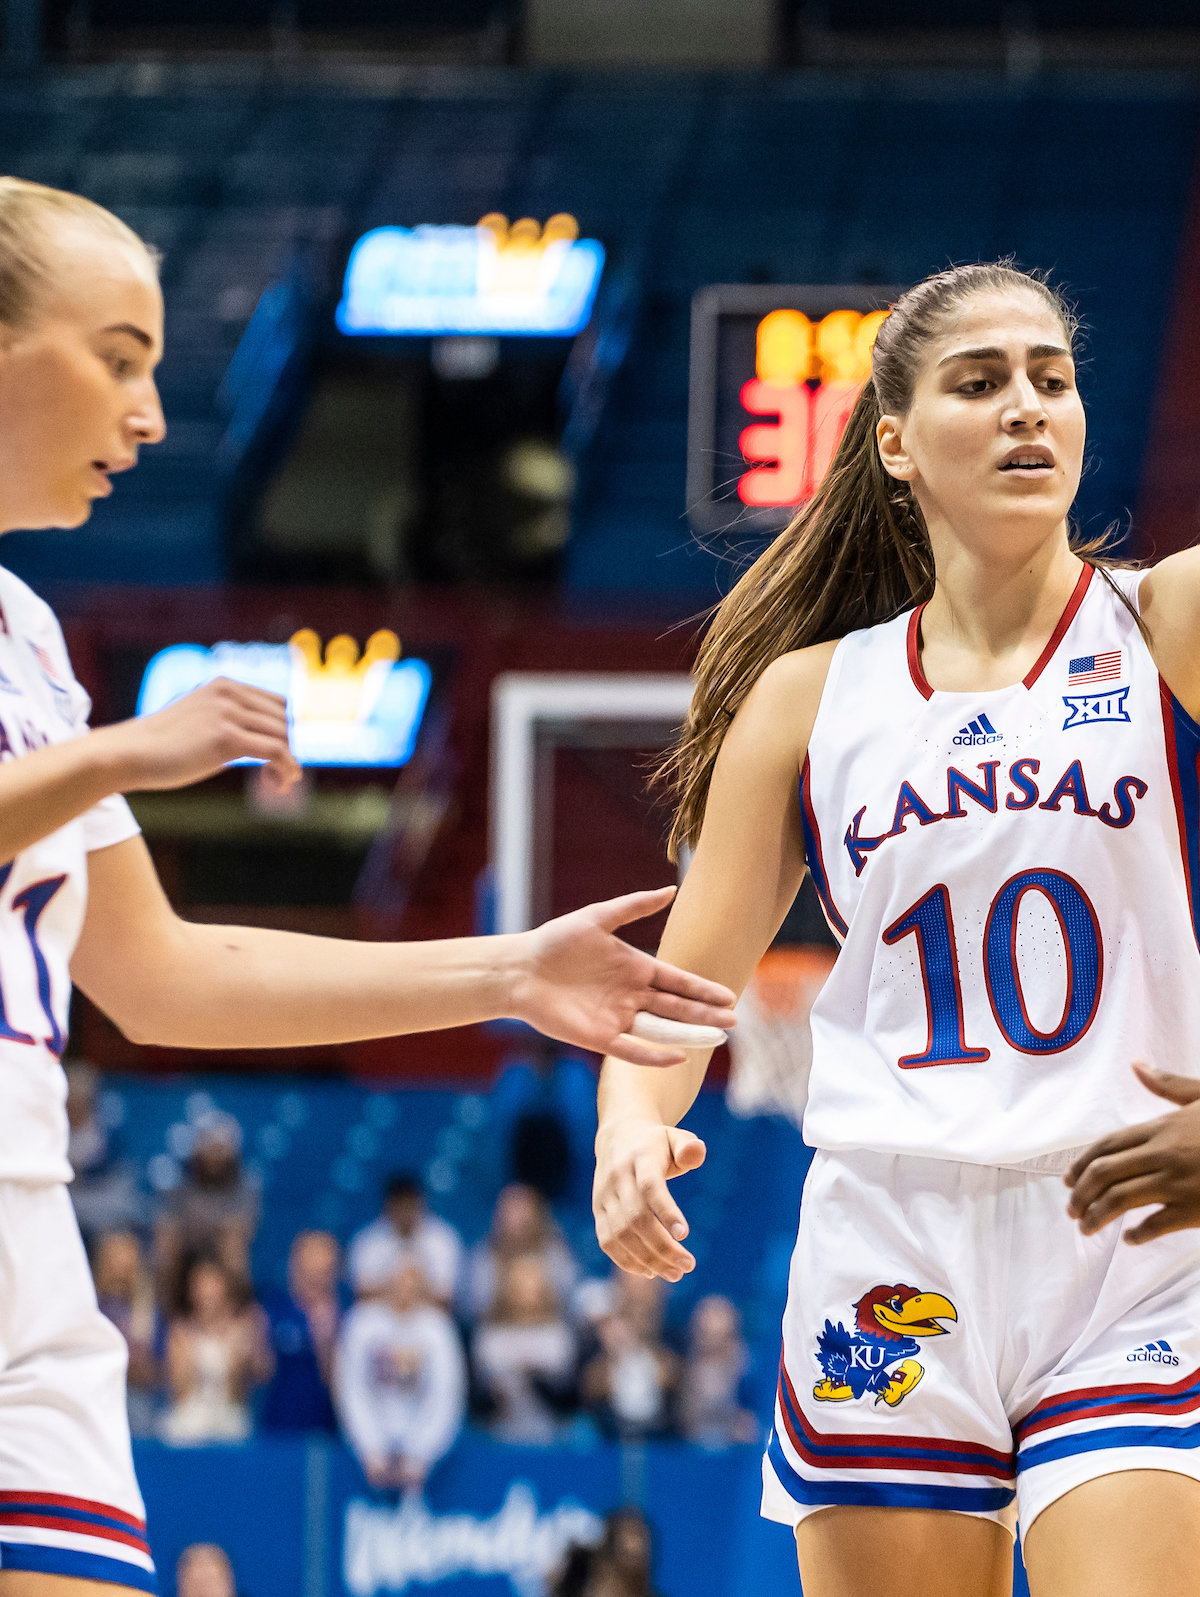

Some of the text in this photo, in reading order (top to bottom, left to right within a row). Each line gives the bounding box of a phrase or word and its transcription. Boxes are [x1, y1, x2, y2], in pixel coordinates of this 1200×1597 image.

[1062, 686, 1132, 731] XII
[952, 732, 1004, 746] adidas
[843, 758, 1149, 877] KANSAS
[881, 867, 1104, 1070] 10
[848, 1345, 887, 1371] KU
[1126, 1350, 1180, 1367] adidas
